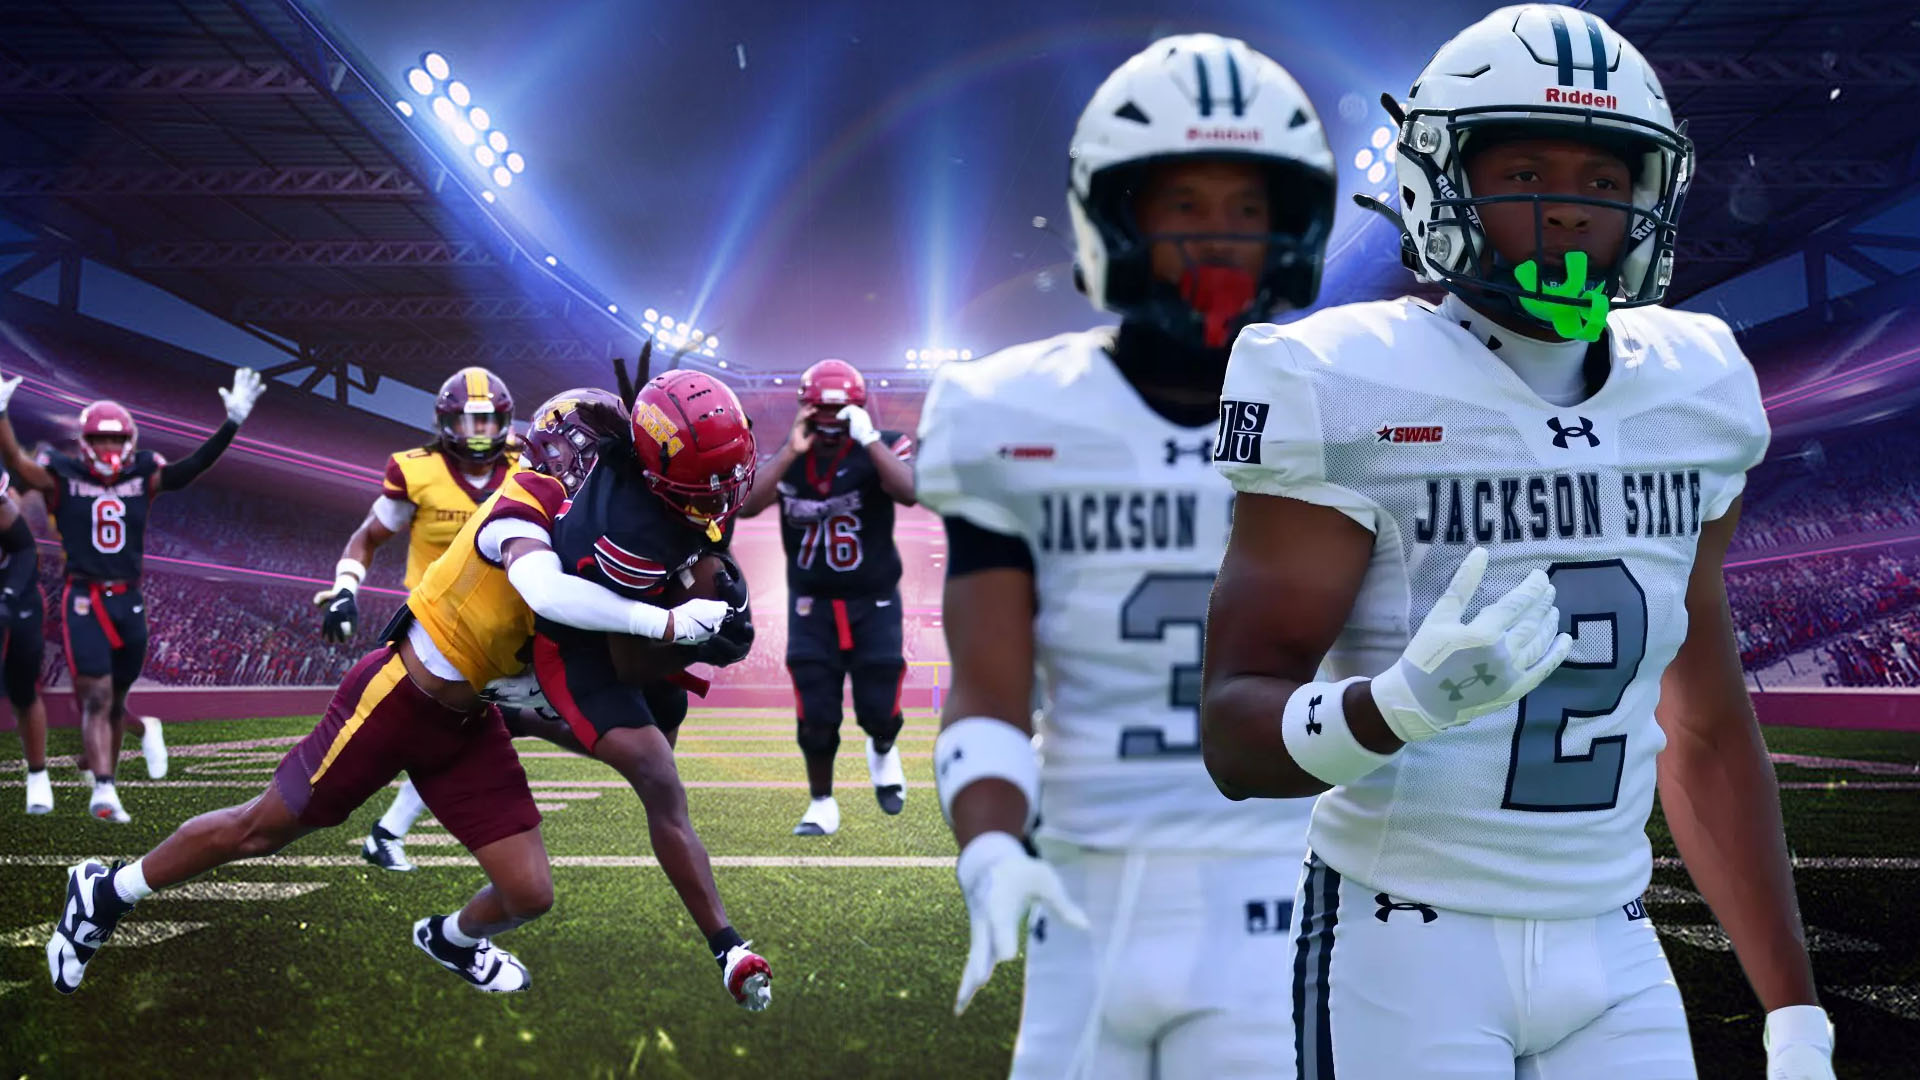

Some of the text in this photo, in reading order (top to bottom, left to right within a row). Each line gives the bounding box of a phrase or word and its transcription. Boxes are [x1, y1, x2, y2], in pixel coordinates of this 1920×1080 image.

[1545, 88, 1617, 110] Riddell
[1392, 426, 1444, 443] SWAC
[91, 494, 126, 554] 6
[1039, 491, 1198, 554] JACKSON
[1415, 469, 1700, 544] JACKSON STATE
[788, 511, 864, 572] 76
[1501, 558, 1649, 812] 2
